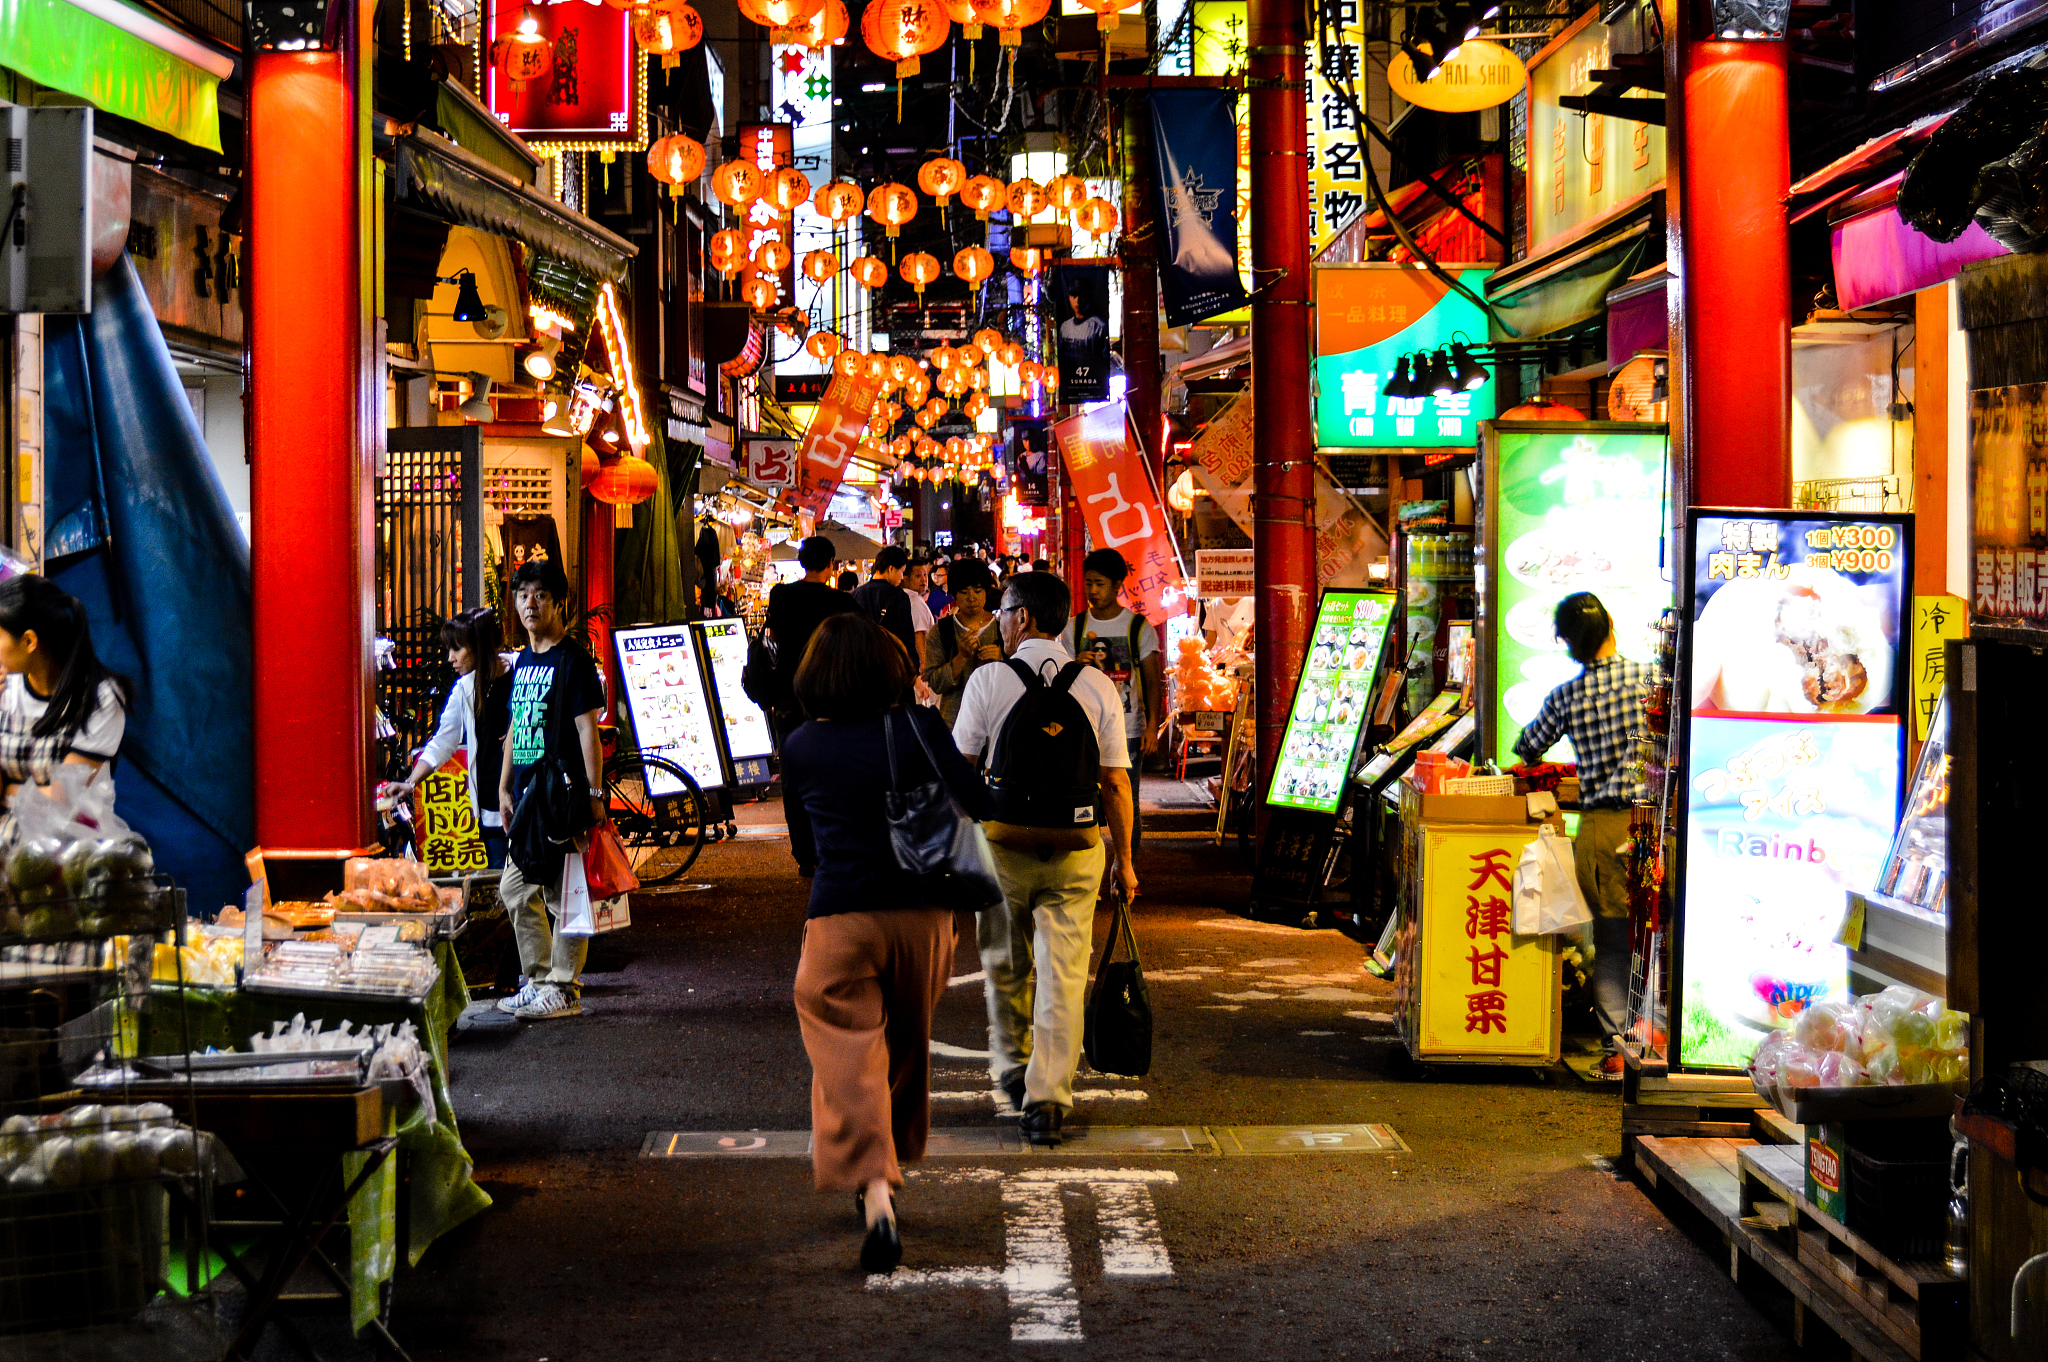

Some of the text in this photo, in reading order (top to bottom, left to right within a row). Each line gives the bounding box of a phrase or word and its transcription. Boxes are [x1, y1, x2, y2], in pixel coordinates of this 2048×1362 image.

[1445, 64, 1468, 85] HAI
[1481, 64, 1510, 85] SHIN
[1325, 304, 1407, 324] 一品料理
[1075, 366, 1090, 377] 47
[806, 414, 857, 469] 占
[754, 445, 789, 482] 占
[1028, 482, 1036, 490] 14
[1721, 521, 1779, 552] 特製
[1806, 526, 1894, 549] 1個 ¥300
[1708, 551, 1790, 581] 肉まん
[1806, 550, 1893, 573] 3個 ¥900
[1739, 785, 1827, 822] アイス
[426, 838, 486, 867] 発売
[1464, 847, 1512, 1035] 天津甘栗
[1810, 1145, 1838, 1180] TSINGTAO
